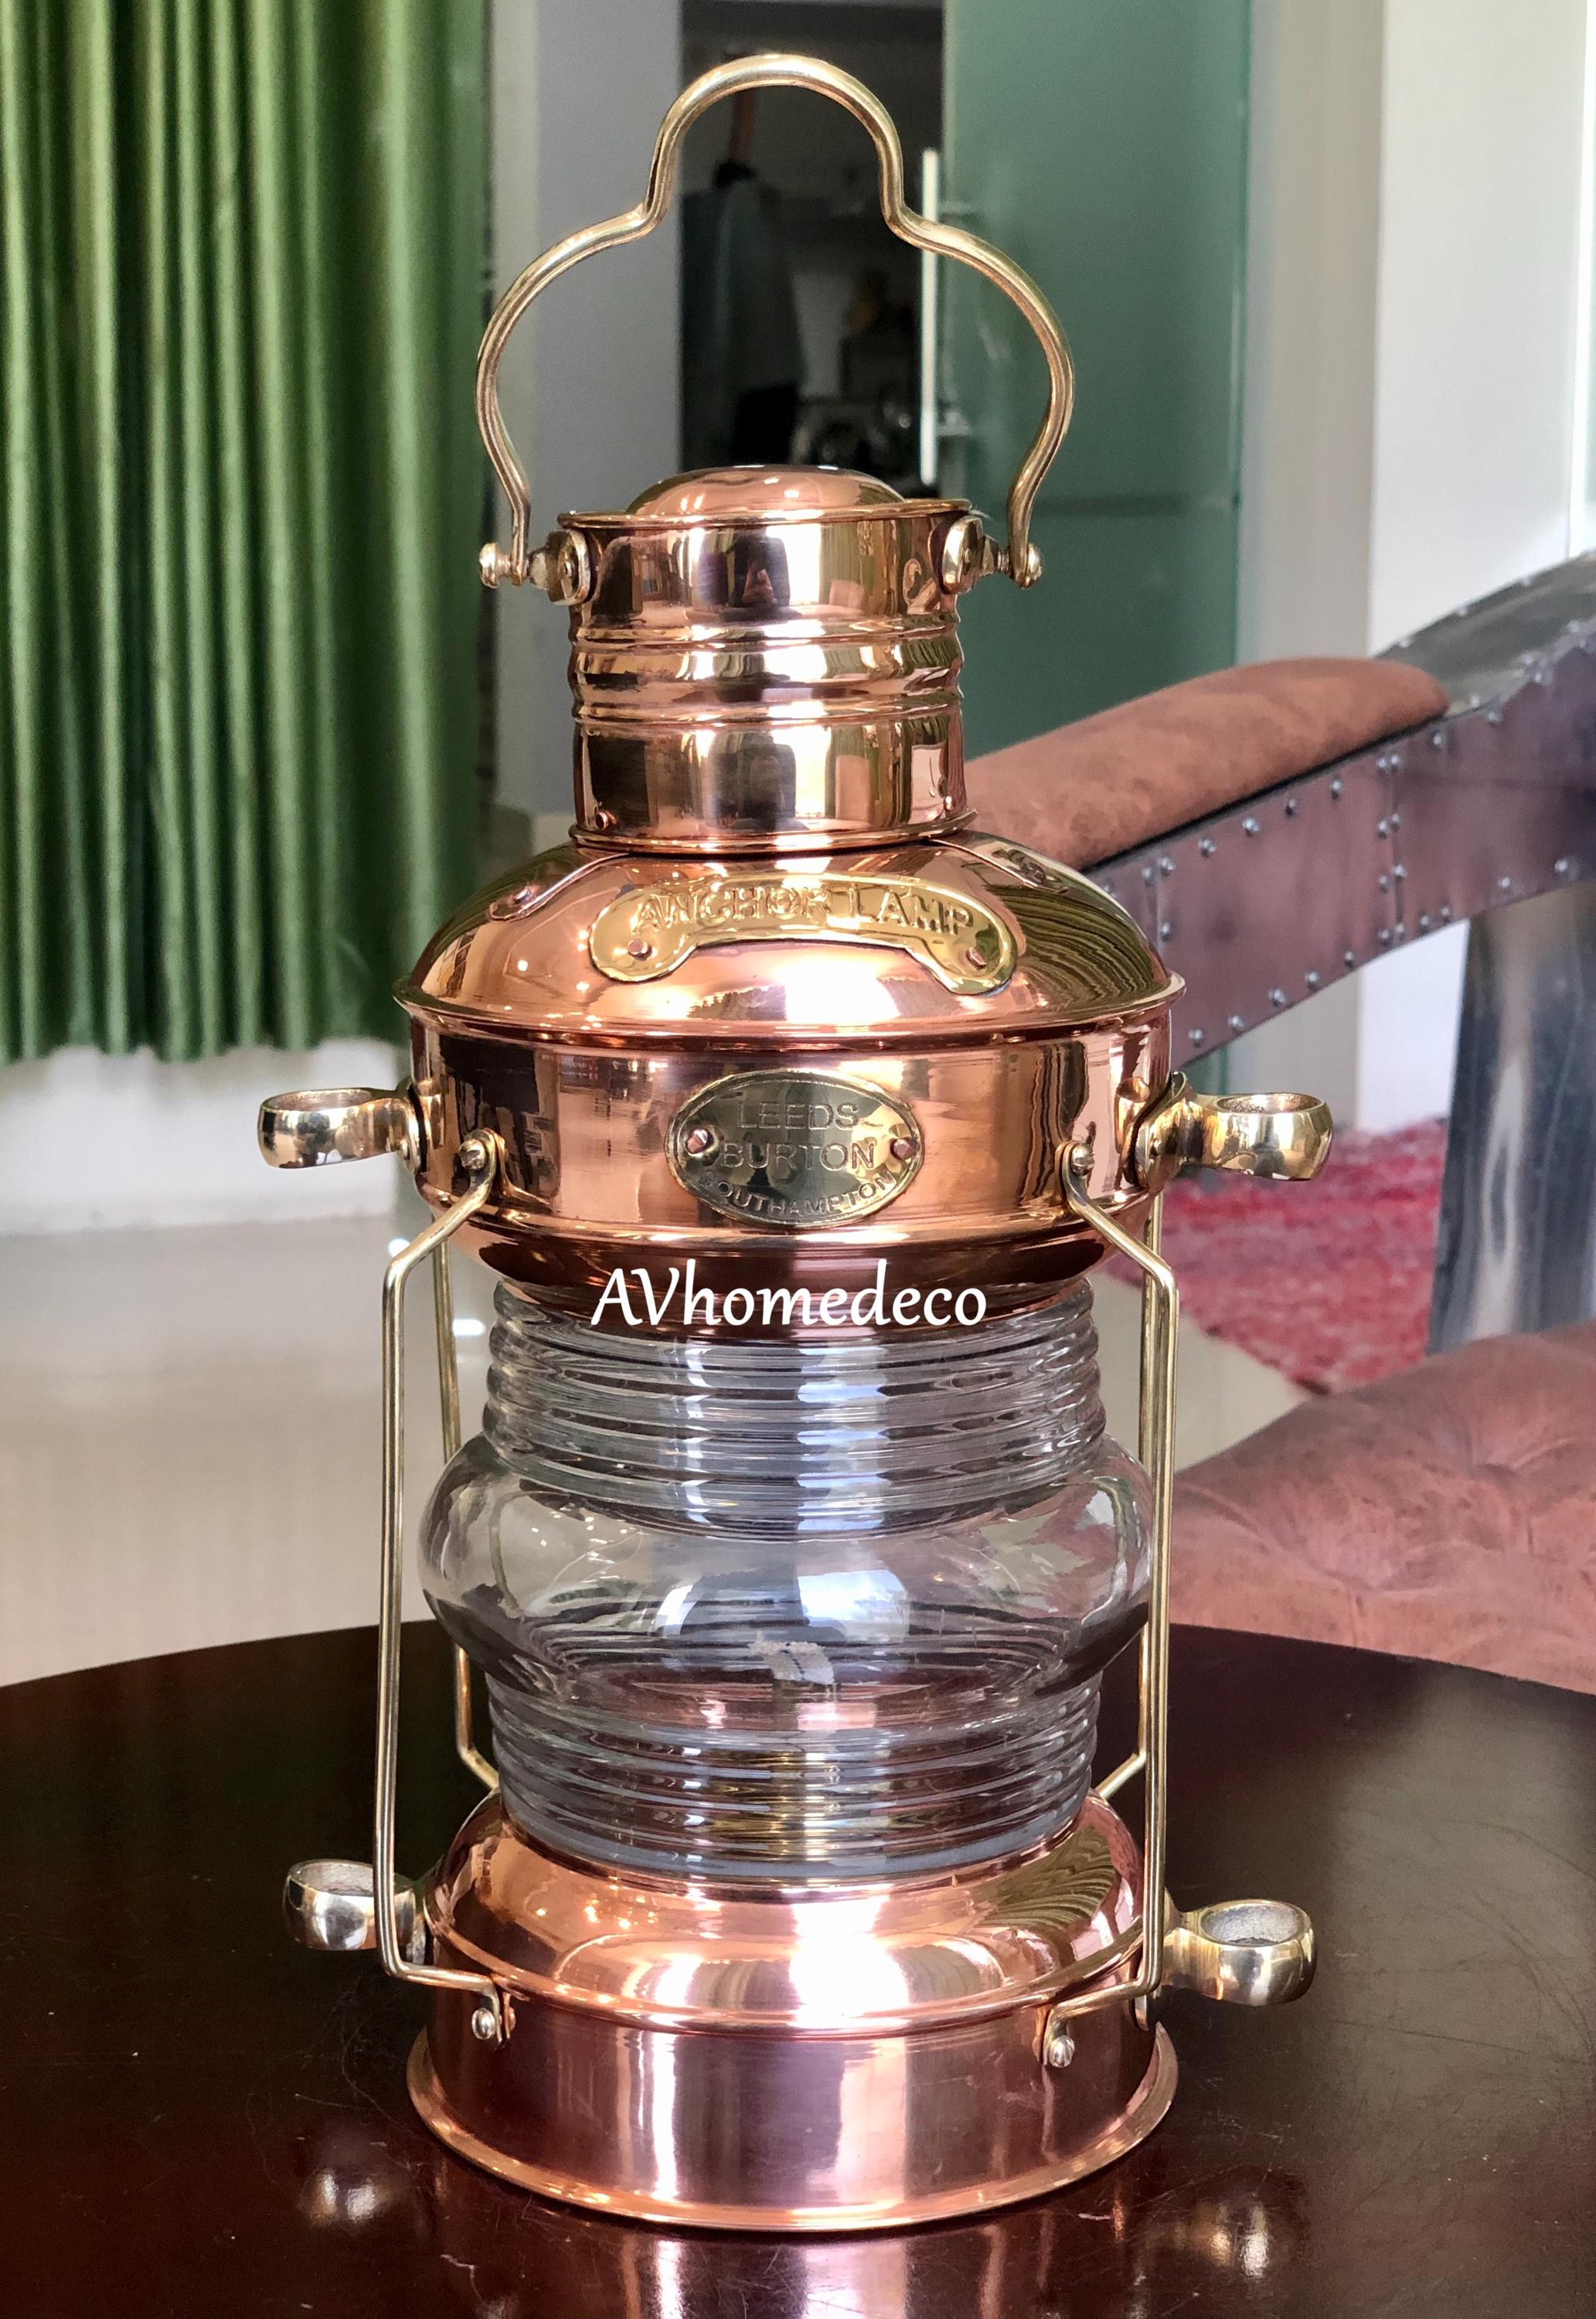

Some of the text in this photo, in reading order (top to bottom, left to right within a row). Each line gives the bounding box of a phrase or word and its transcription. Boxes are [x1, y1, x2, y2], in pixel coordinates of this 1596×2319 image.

[629, 884, 975, 935] ANCHOR LAMP
[737, 1102, 859, 1131] LEEDS
[720, 1142, 876, 1171] BURTON
